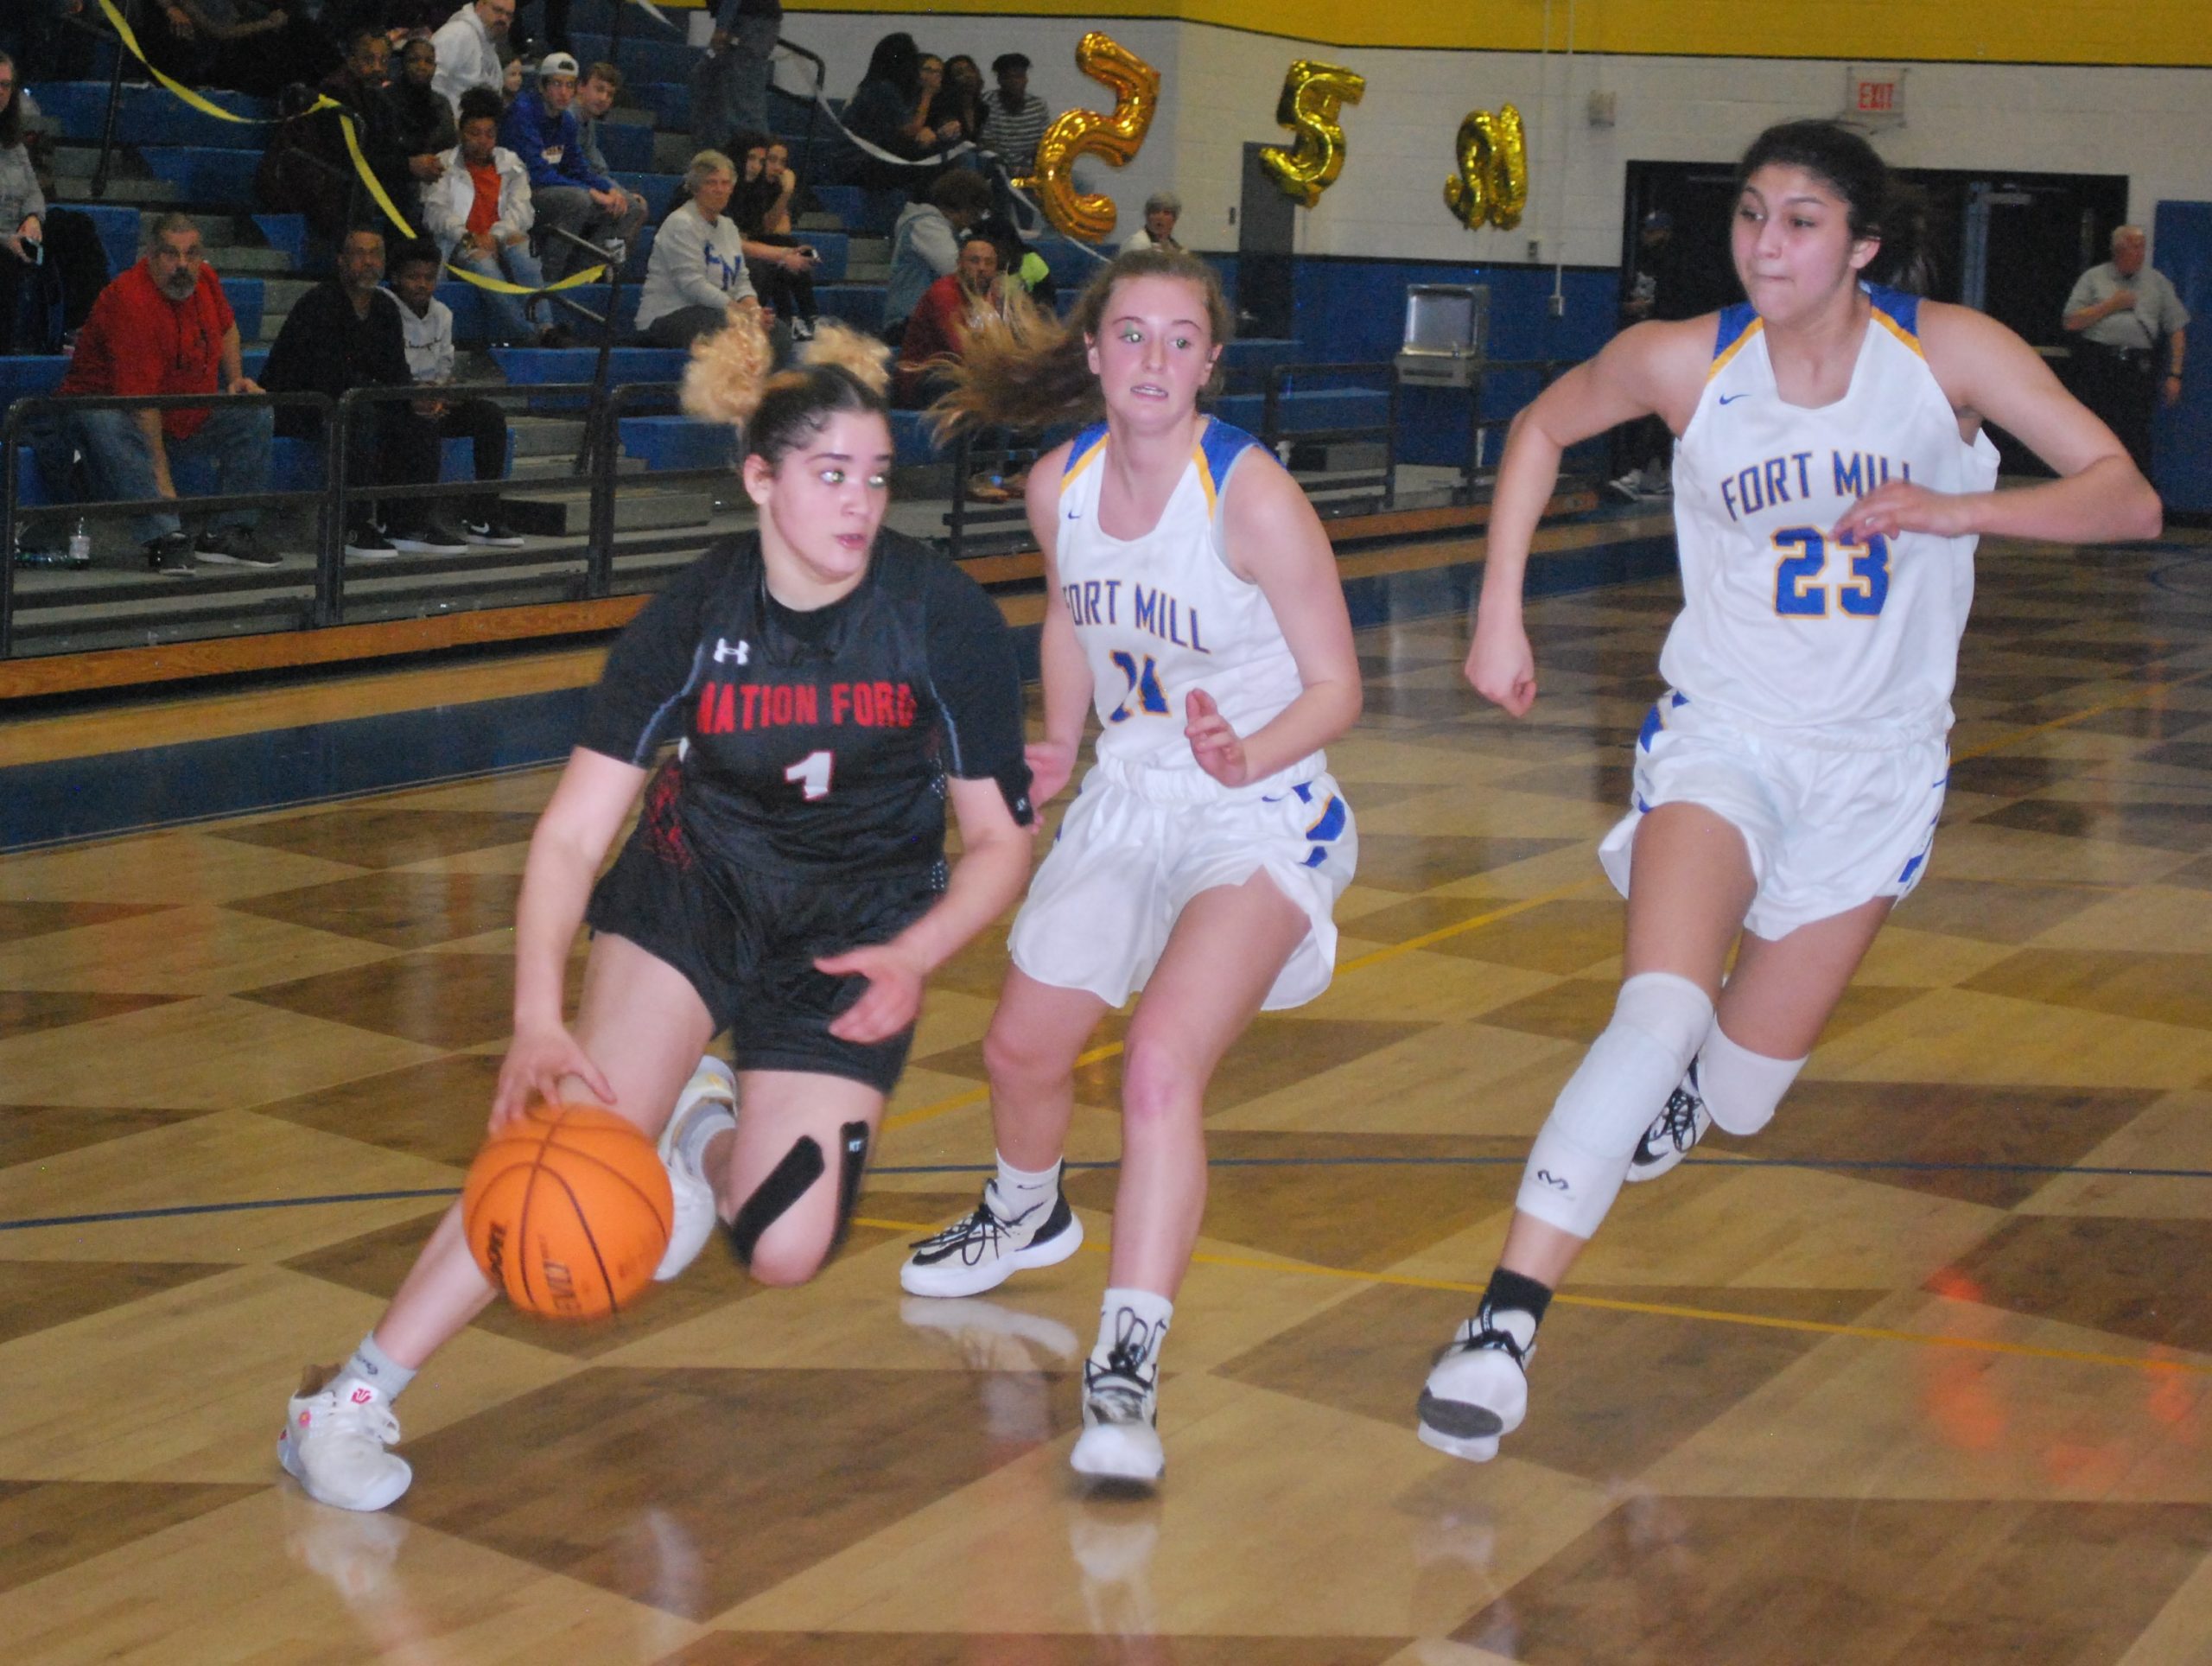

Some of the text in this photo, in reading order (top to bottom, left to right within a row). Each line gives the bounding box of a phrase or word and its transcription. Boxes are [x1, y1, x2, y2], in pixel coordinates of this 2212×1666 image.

[1857, 81, 1895, 111] EXIT
[1720, 451, 1813, 523] FORT
[1770, 524, 1893, 620] 23
[1134, 582, 1211, 655] MILL
[784, 749, 836, 802] 1
